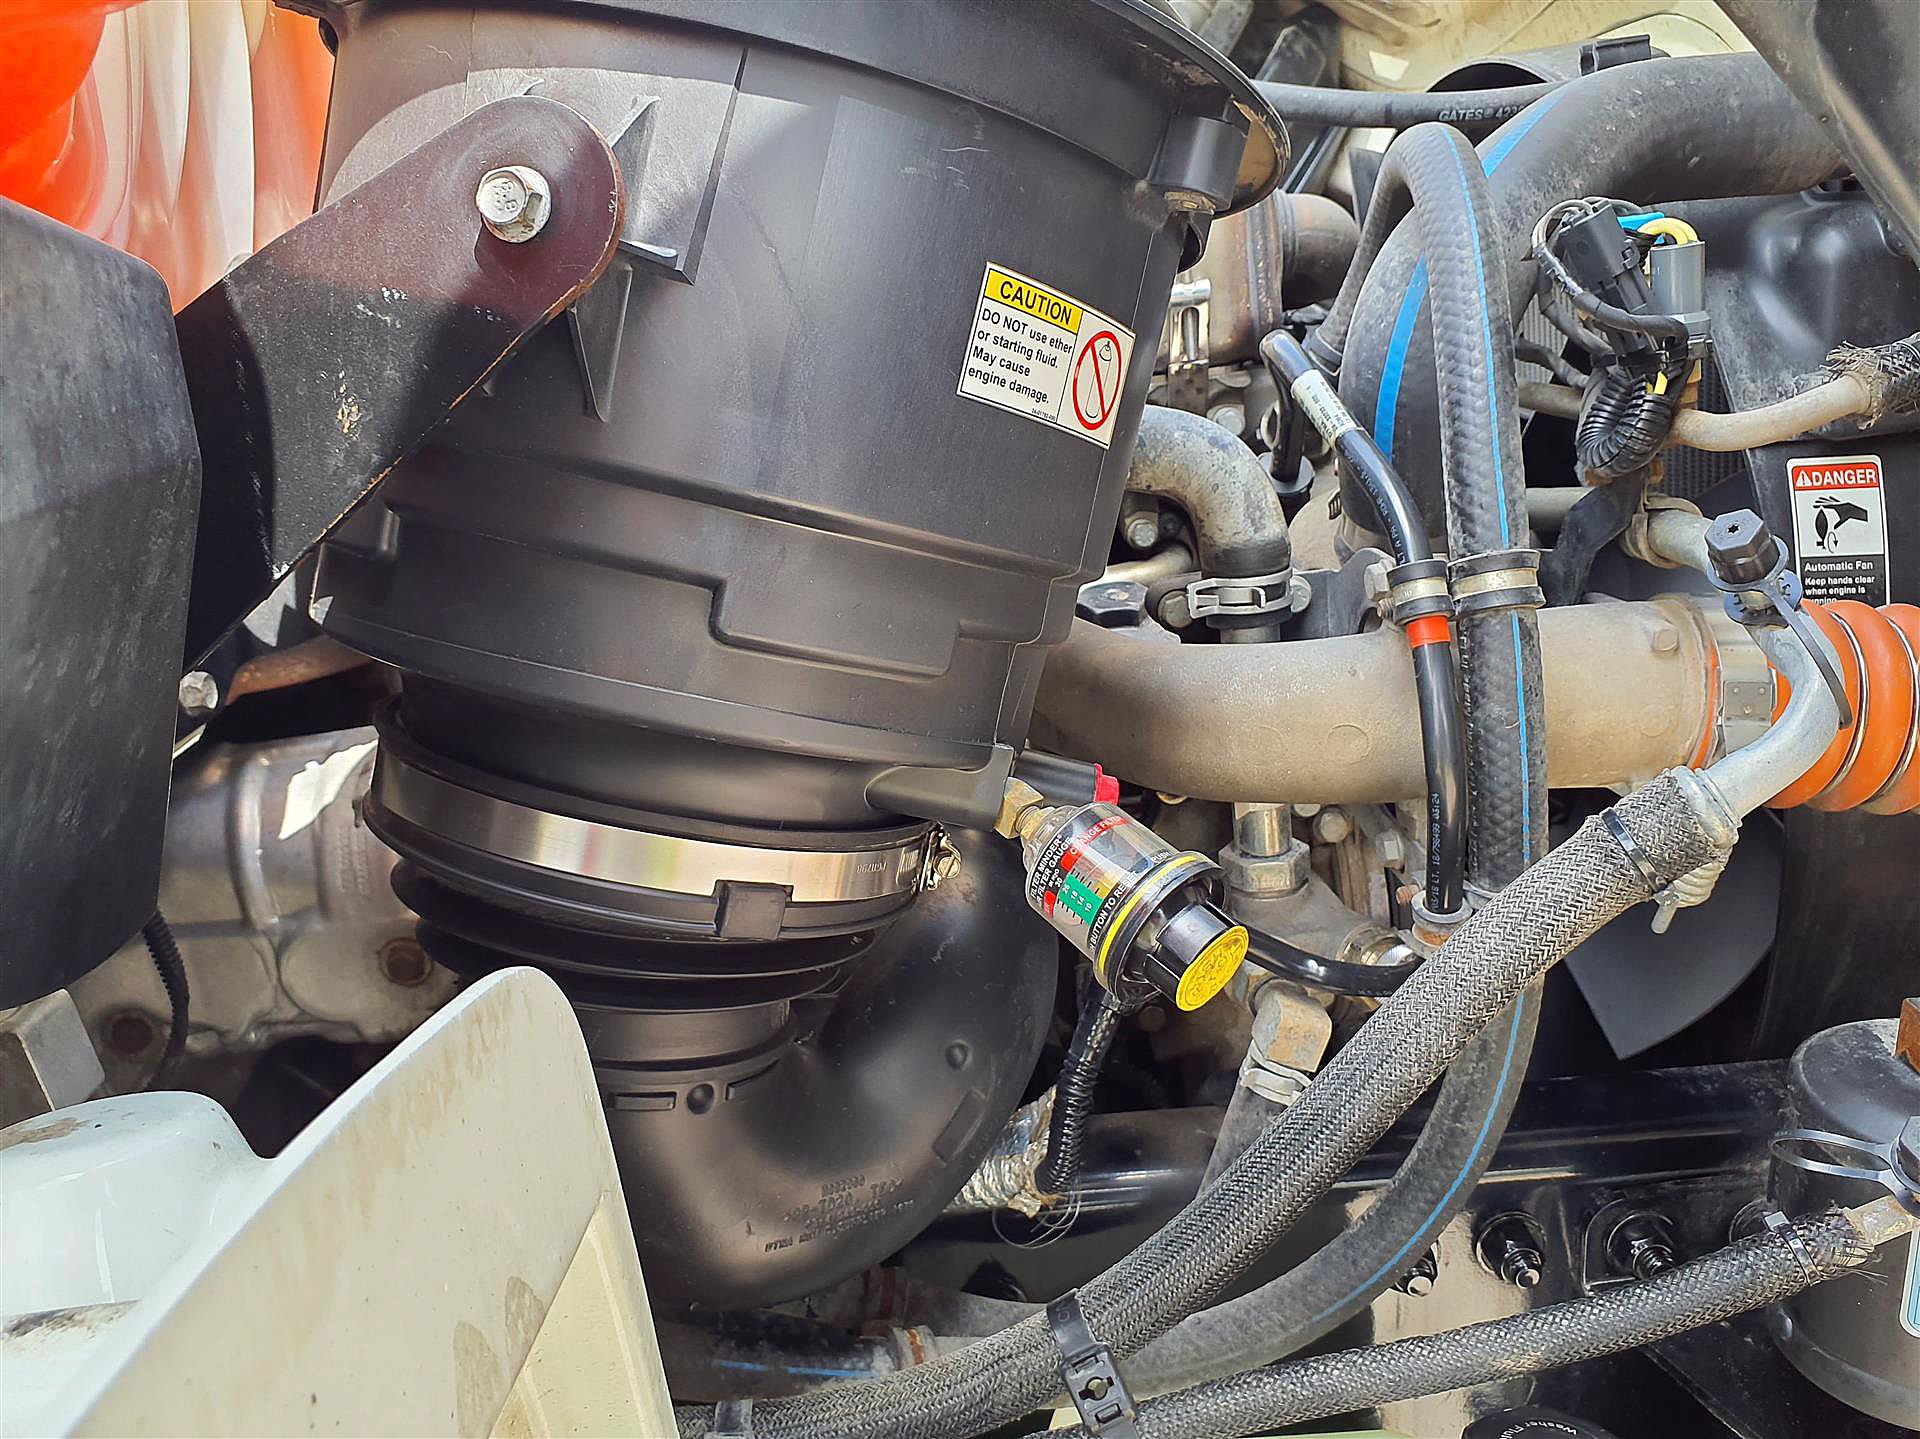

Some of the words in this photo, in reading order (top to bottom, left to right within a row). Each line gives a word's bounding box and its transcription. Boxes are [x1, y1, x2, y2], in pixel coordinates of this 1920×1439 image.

[1000, 281, 1072, 325] CAUTION
[982, 308, 1001, 325] DO
[1003, 316, 1028, 335] NOT
[1030, 329, 1047, 344] use
[1049, 337, 1073, 355] ether
[972, 346, 997, 367] May
[999, 358, 1031, 377] cause
[977, 330, 991, 341] or
[992, 333, 1033, 361] starting
[1035, 346, 1058, 369] fluid.
[968, 366, 1006, 388] engine
[1008, 379, 1049, 404] damage.
[1811, 469, 1877, 486] DANGER
[1804, 560, 1853, 572] Automatic
[1855, 560, 1873, 570] Fan
[1805, 577, 1826, 587] Keep
[1828, 576, 1853, 585] hands
[1855, 575, 1875, 584] clear
[1805, 587, 1827, 595] when
[1829, 587, 1856, 597] engine
[1858, 586, 1866, 594] is
[1037, 867, 1052, 899] FILTER
[1048, 836, 1073, 868] GAUGE
[1031, 872, 1041, 899] FILTER
[1084, 902, 1092, 912] 10
[1091, 909, 1109, 944] BUTTON
[1104, 897, 1116, 911] TO
[1114, 871, 1139, 899] RESET
[1524, 1421, 1577, 1436] Washer
